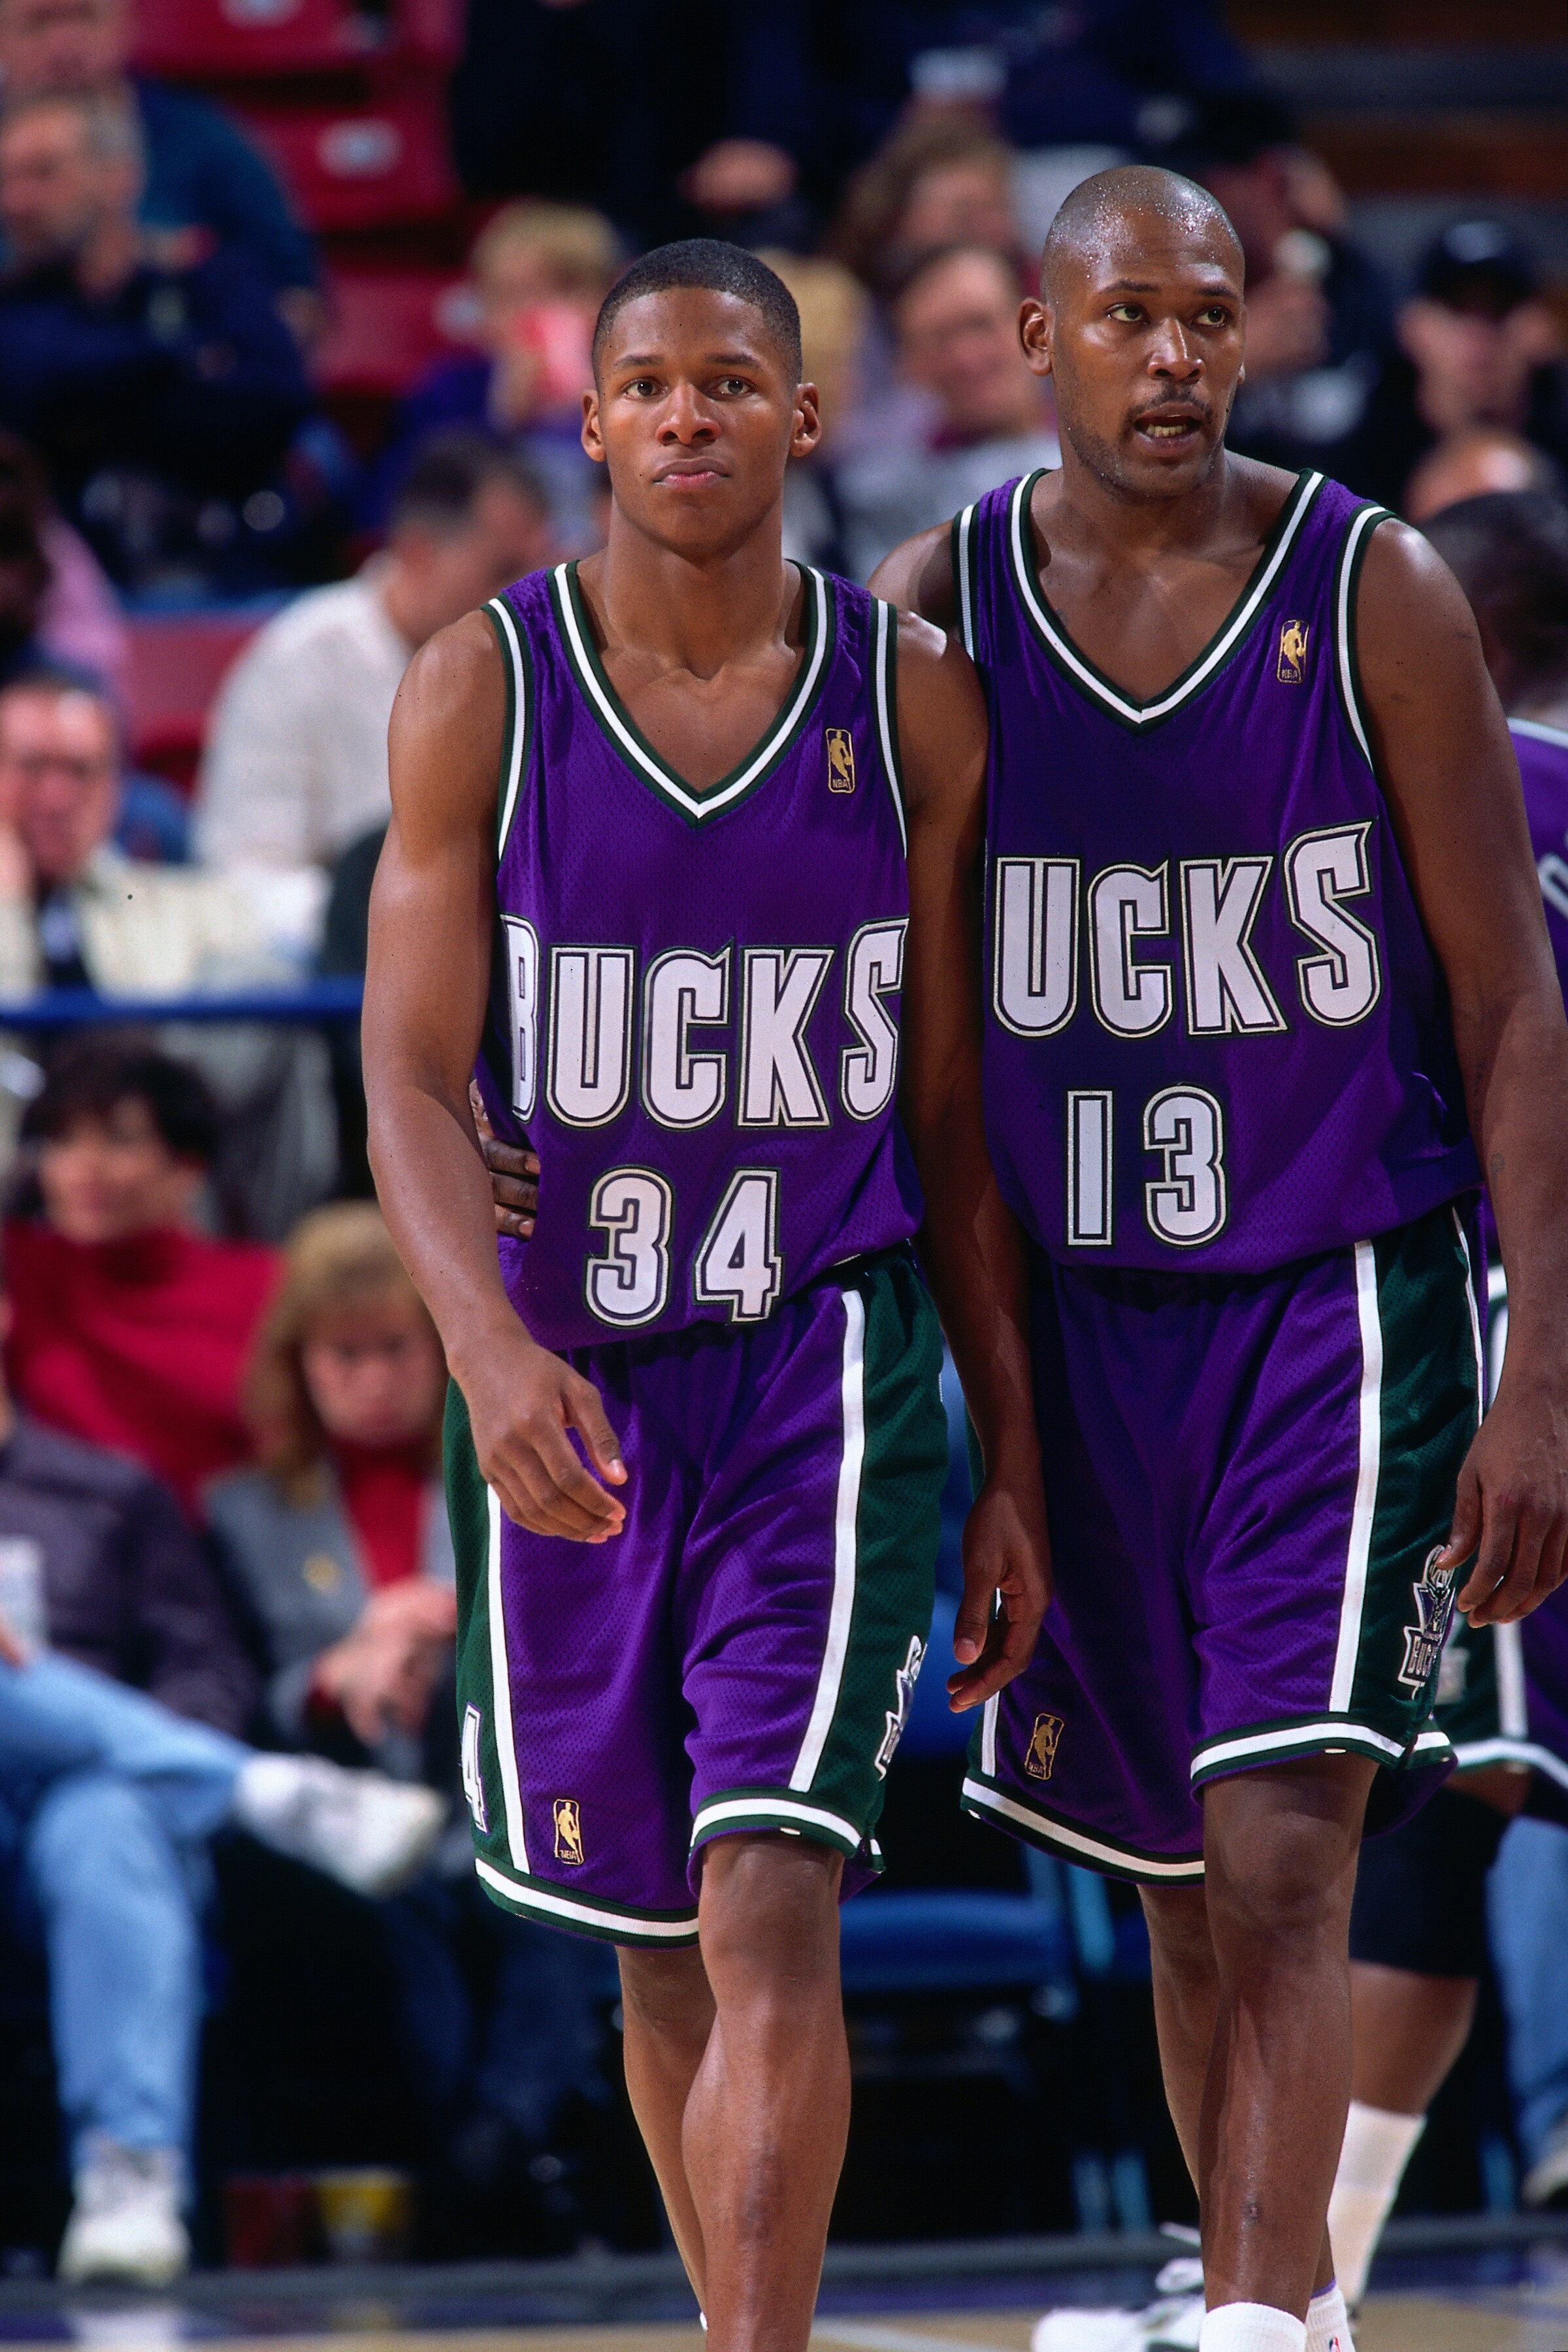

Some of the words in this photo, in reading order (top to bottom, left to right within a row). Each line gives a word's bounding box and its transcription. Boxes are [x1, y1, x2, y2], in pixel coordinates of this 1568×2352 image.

[1281, 668, 1298, 679] NBA
[832, 778, 848, 788] NBA
[985, 819, 1383, 1039] UCKS
[499, 912, 909, 1131] BUCKS
[1066, 1083, 1228, 1249] 13
[583, 1165, 783, 1328] 34
[1028, 1762, 1043, 1774] NBA
[559, 1849, 577, 1860] NBA
